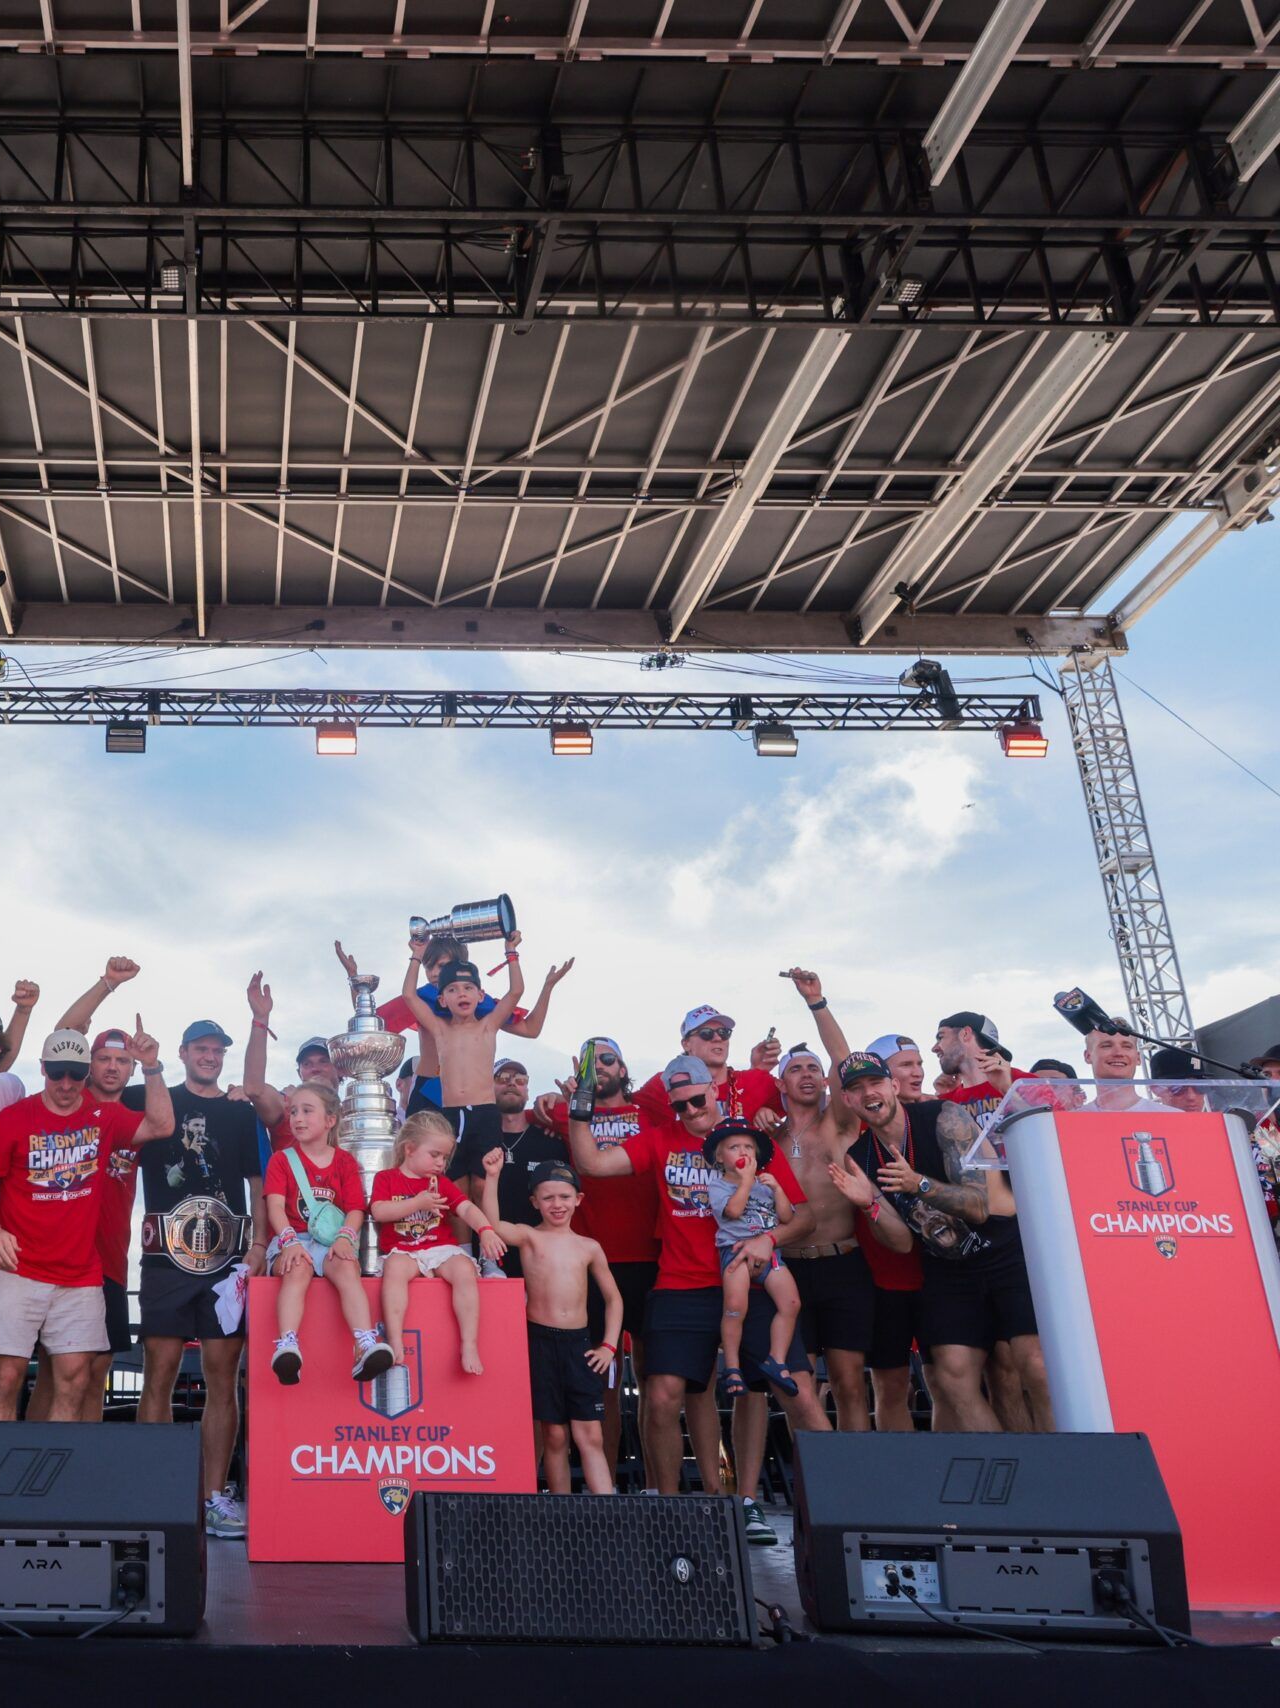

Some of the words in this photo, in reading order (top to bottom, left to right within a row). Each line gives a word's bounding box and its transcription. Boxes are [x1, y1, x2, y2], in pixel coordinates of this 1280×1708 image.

[590, 1122, 640, 1138] AMPS
[28, 1138, 100, 1169] CHAMPS
[1117, 1201, 1171, 1212] STANLEY
[1174, 1201, 1198, 1212] CUP
[1089, 1213, 1234, 1234] CHAMPIONS
[334, 1425, 412, 1442] STANLEY
[416, 1425, 450, 1442] CUP
[290, 1444, 496, 1475] CHAMPIONS
[22, 1559, 63, 1569] ARA
[996, 1564, 1039, 1575] ARA
